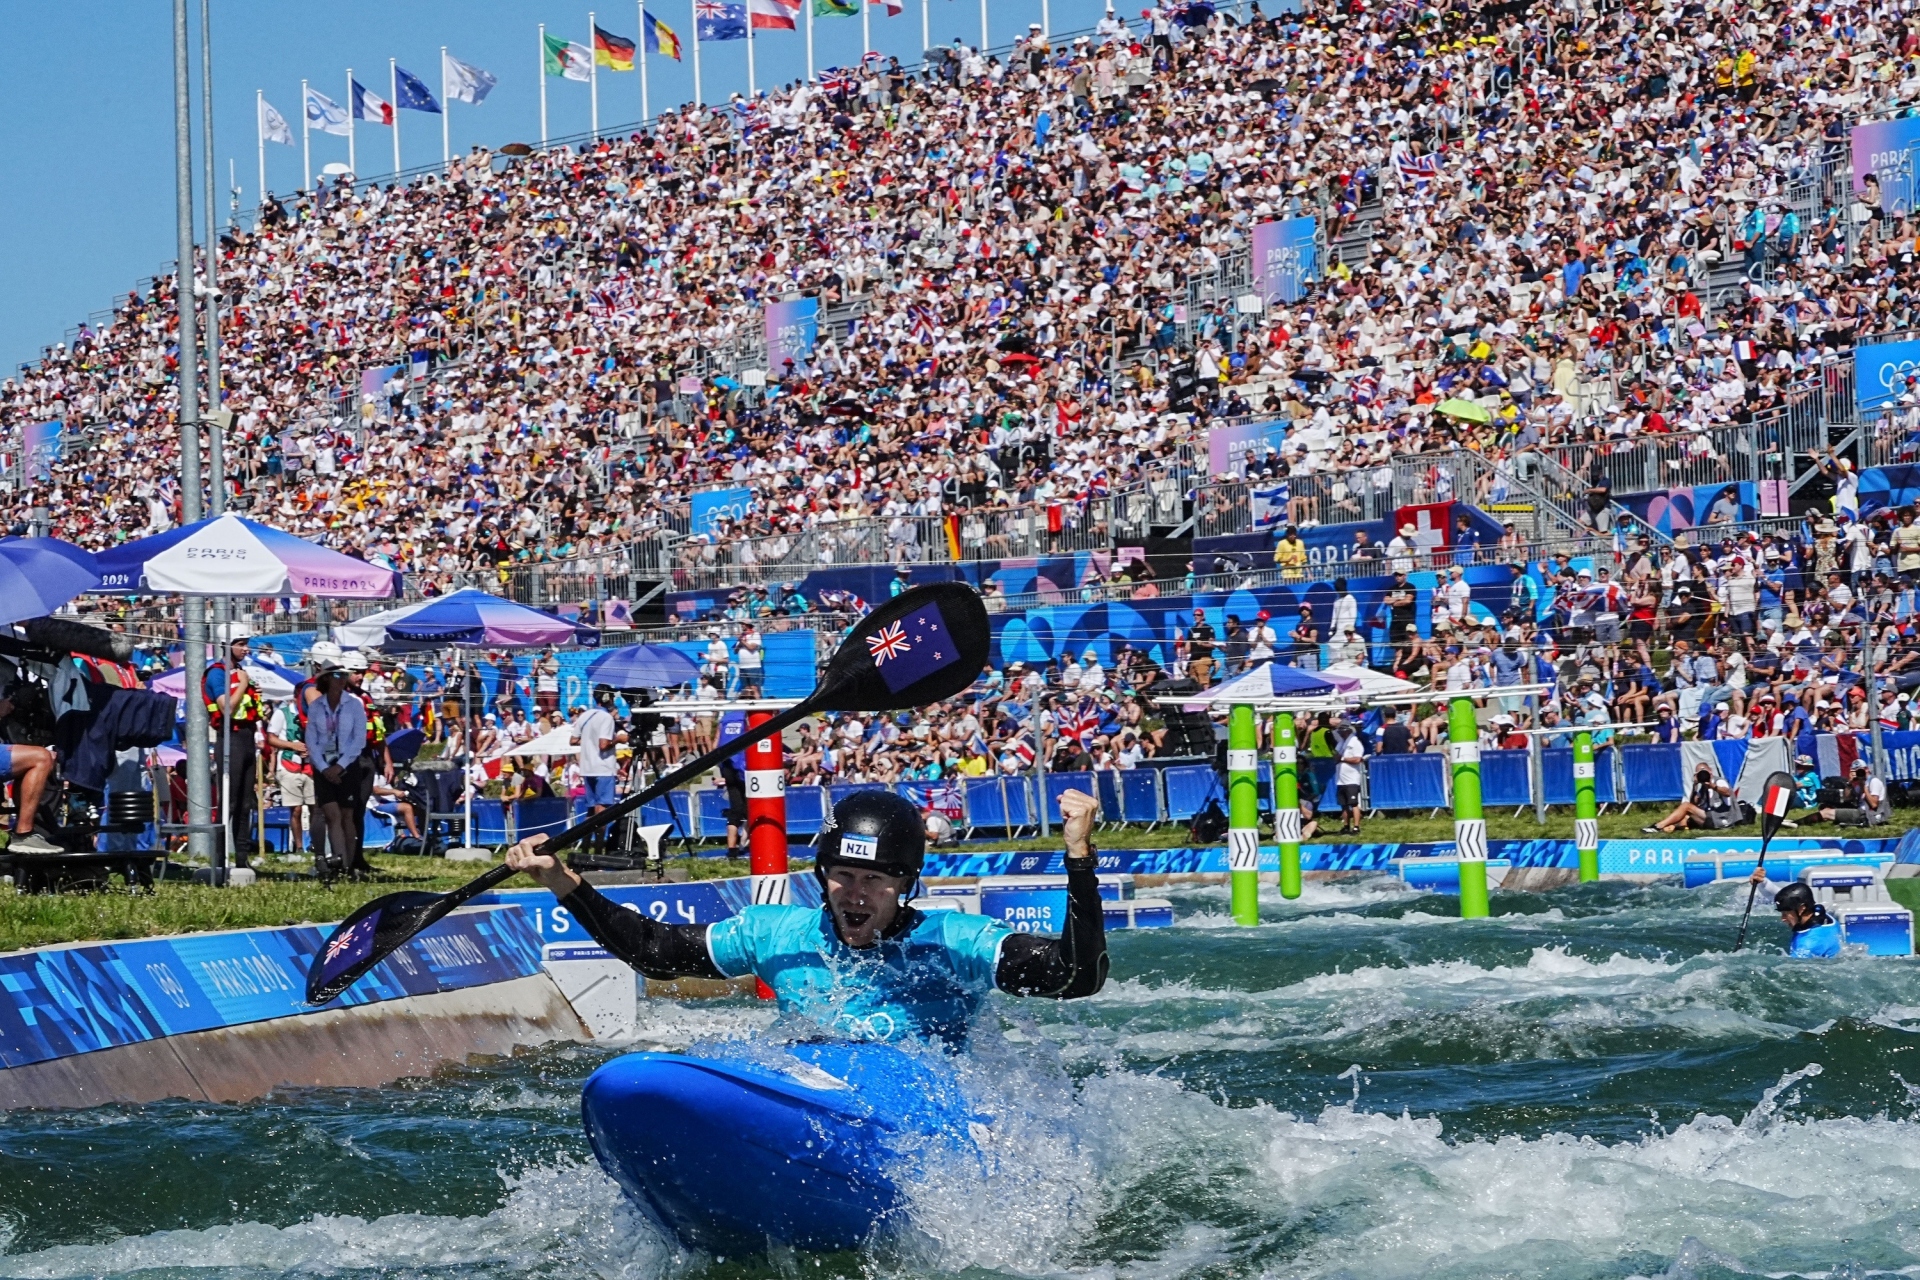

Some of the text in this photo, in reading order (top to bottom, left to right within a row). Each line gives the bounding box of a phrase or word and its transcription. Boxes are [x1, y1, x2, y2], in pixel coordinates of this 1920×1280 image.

[102, 574, 129, 586] 2024
[342, 579, 376, 590] 2024
[1279, 750, 1287, 760] 6
[1454, 746, 1461, 759] 7
[1247, 754, 1254, 766] 7
[1578, 766, 1585, 775] 5
[750, 775, 784, 792] 8 8
[846, 842, 869, 856] NZL
[1097, 856, 1121, 868] 024
